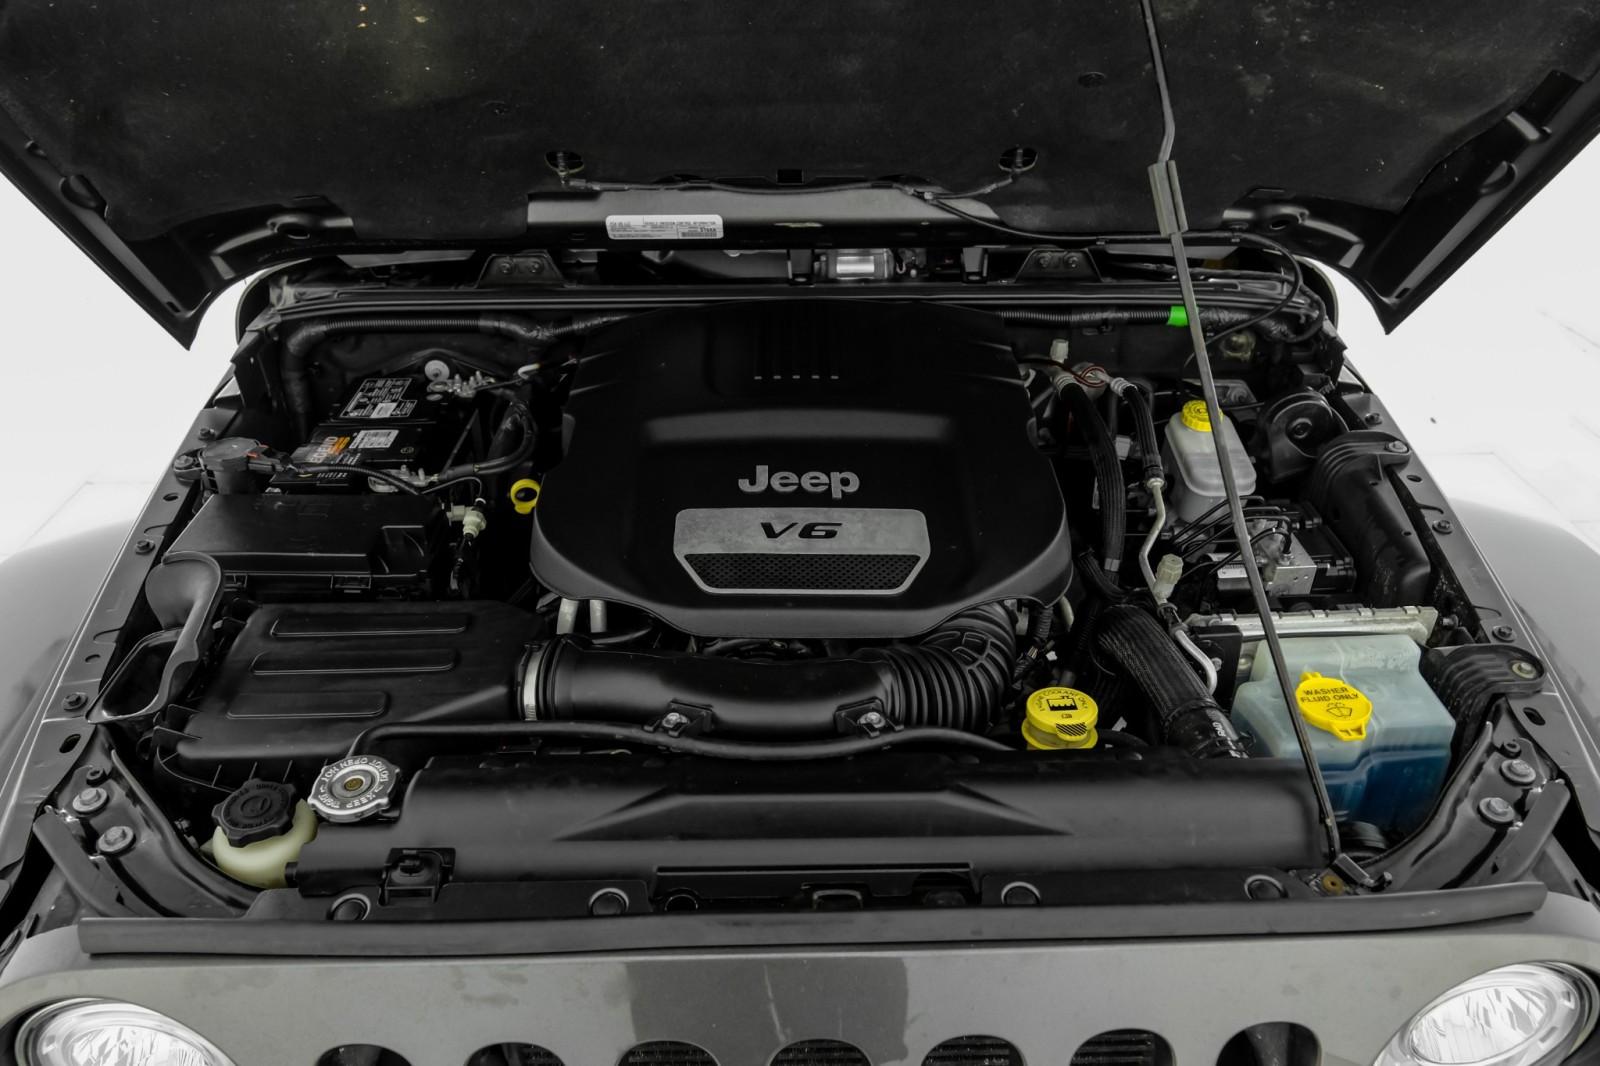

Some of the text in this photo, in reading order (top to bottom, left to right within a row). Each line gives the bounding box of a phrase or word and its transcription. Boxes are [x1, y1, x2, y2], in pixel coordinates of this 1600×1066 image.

[309, 436, 339, 463] EGEND
[738, 465, 860, 499] Jeep
[760, 522, 843, 539] V6
[1300, 693, 1359, 703] FLUID ONLY
[1303, 687, 1349, 696] WASHER
[340, 757, 368, 769] OPEN
[321, 766, 339, 782] HOT
[318, 793, 376, 809] KEEP TIGHT
